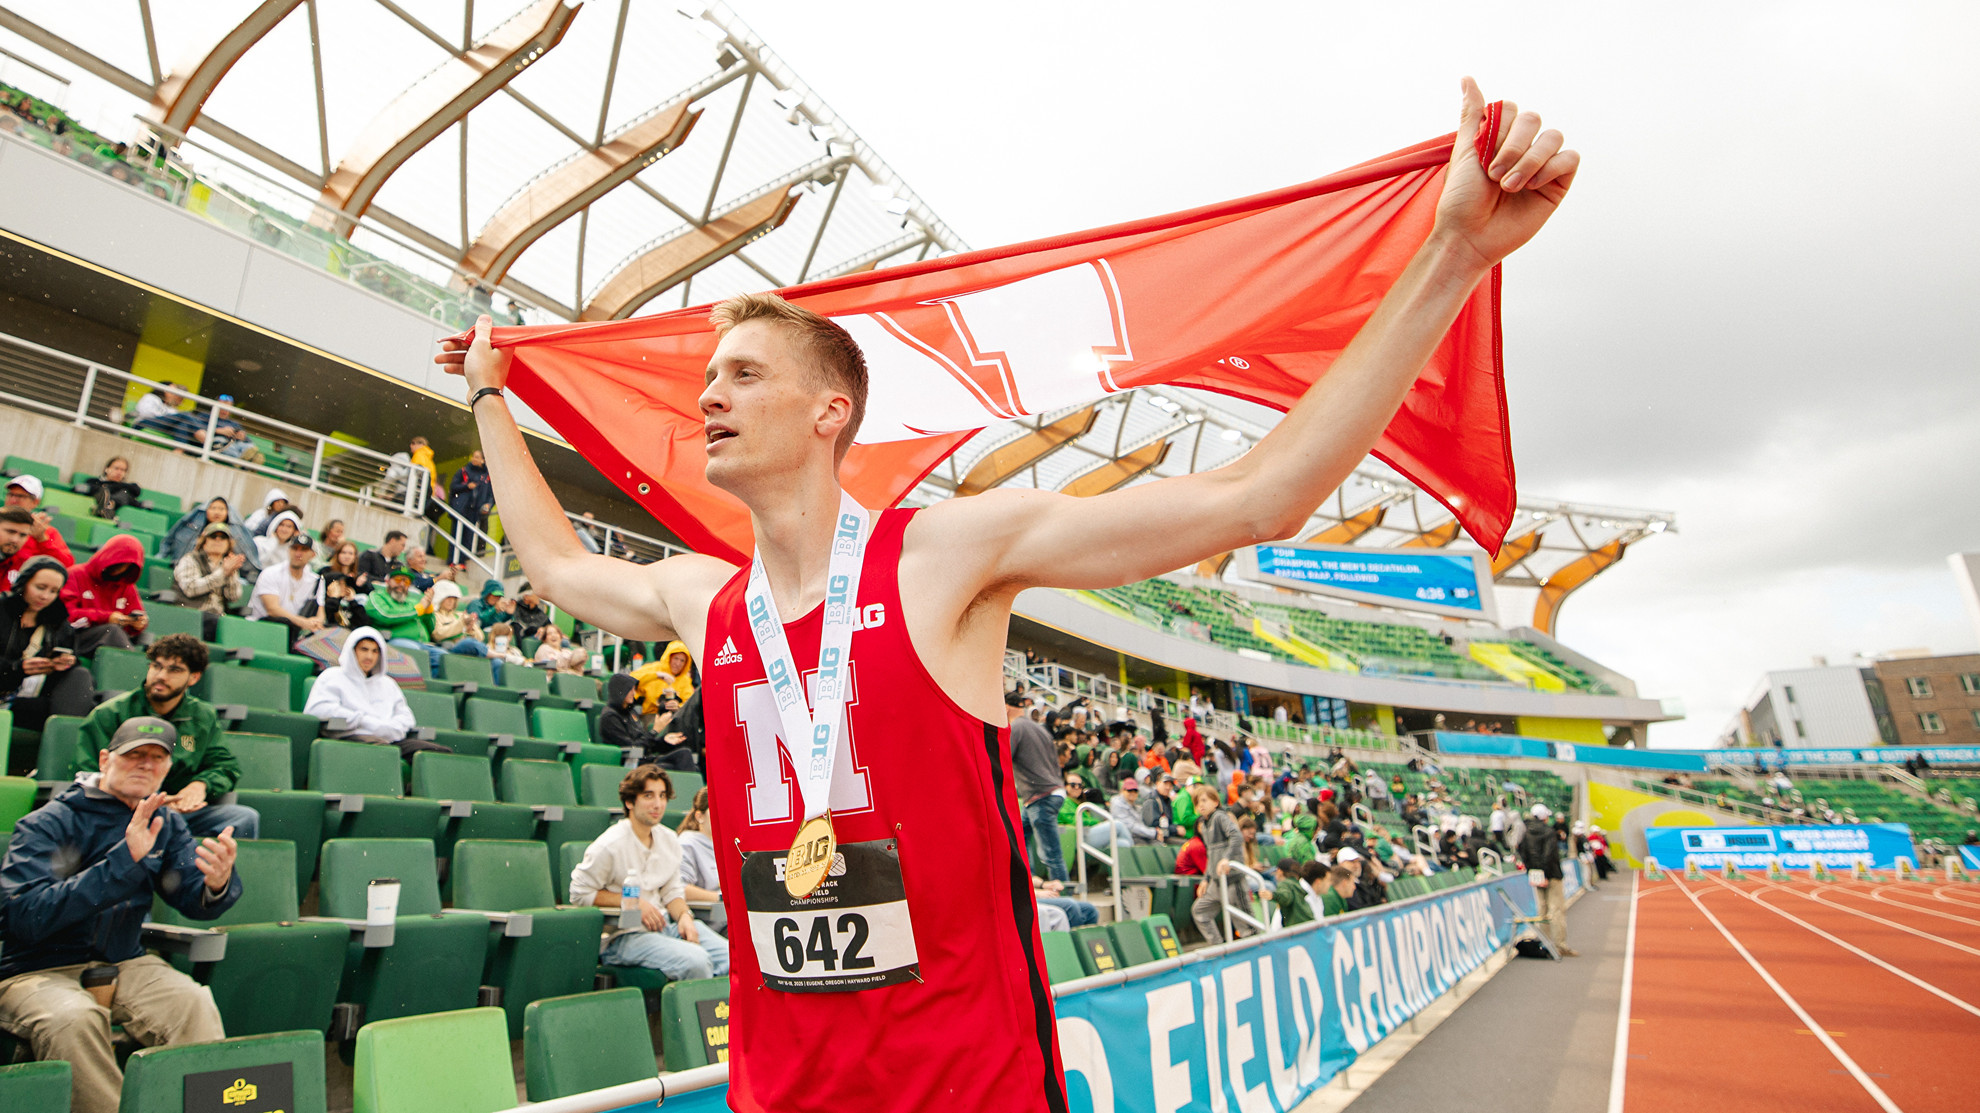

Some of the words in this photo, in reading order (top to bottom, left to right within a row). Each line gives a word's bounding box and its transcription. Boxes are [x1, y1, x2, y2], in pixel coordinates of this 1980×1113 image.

[1272, 548, 1295, 557] YOUR
[1321, 561, 1338, 570] THE
[1334, 572, 1380, 583] FOLLOWED
[714, 653, 743, 667] adidas
[821, 880, 839, 888] RACK
[790, 896, 839, 906] CHAMPIONSHIPS
[773, 912, 876, 974] 642
[871, 974, 886, 982] FIELD
[1146, 945, 1324, 1113] FIELD
[1332, 887, 1501, 1056] CHAMPIONSHIPS
